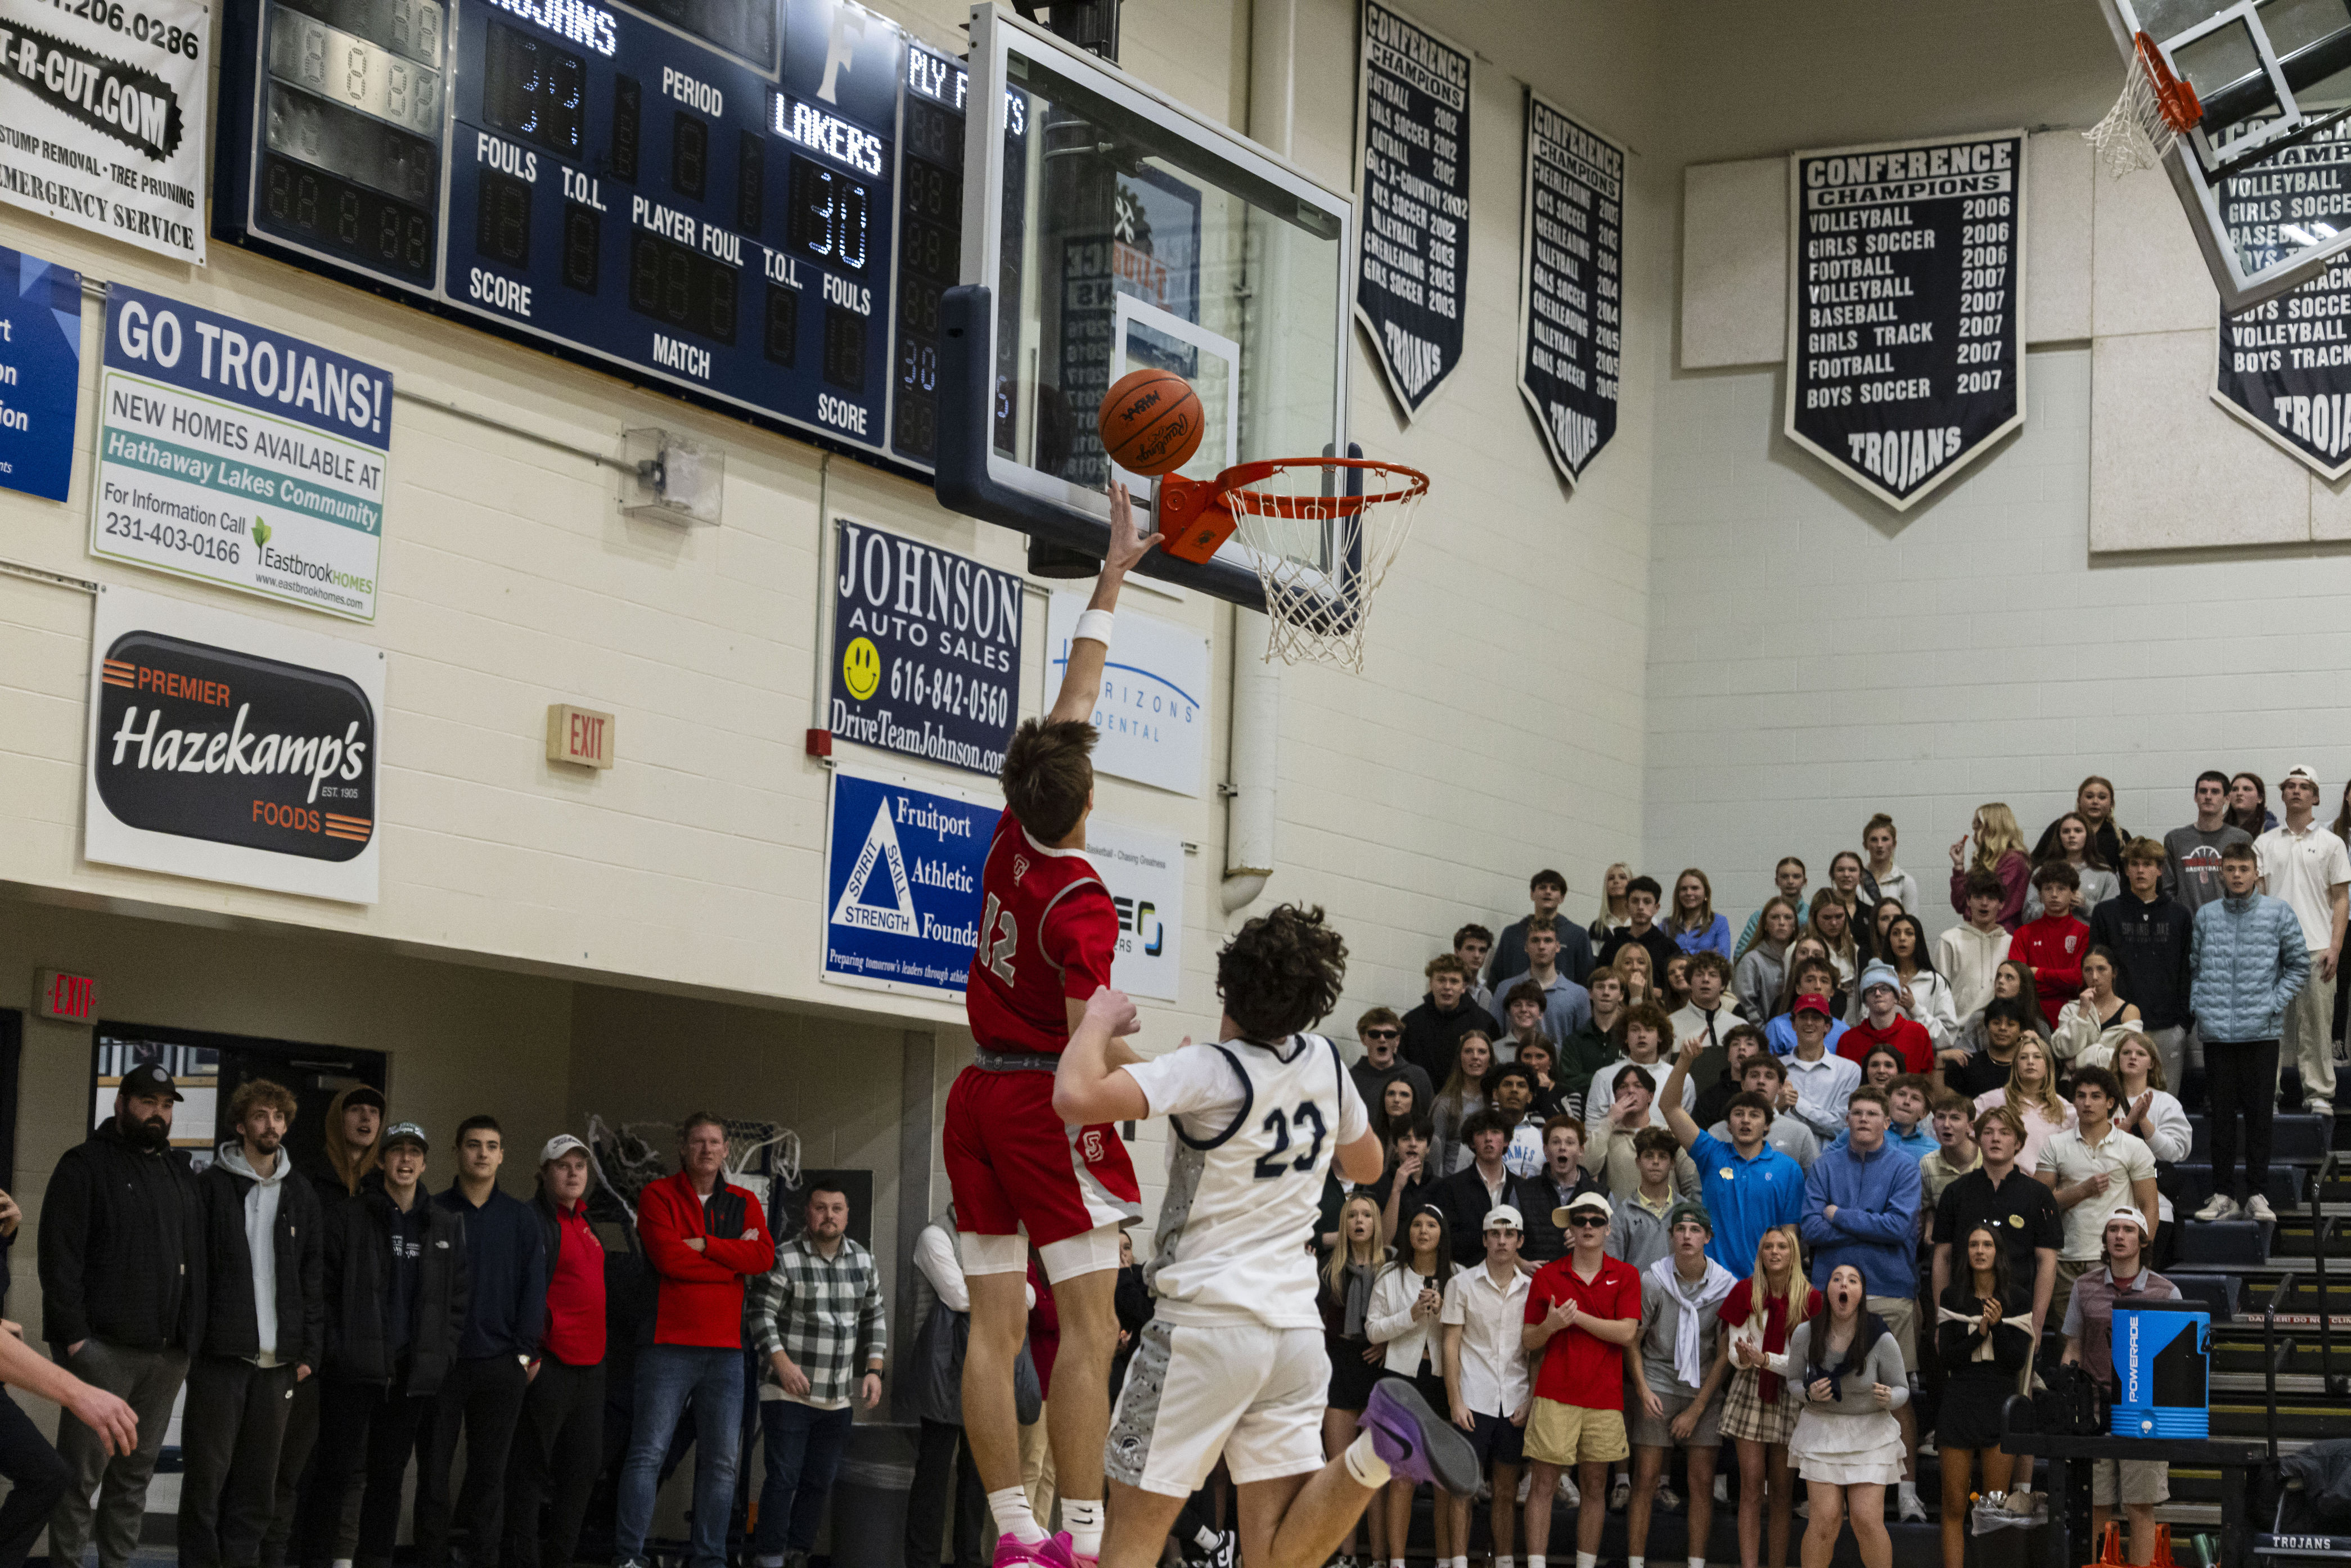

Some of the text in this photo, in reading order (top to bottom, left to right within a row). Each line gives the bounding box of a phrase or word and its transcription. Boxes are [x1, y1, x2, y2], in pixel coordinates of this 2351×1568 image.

[52, 0, 199, 60] .206.0286
[1367, 4, 1467, 89] CONFERENCE
[663, 66, 723, 118] PERIOD
[909, 48, 947, 98] PLY
[1372, 43, 1461, 107] CHAMPIONS
[775, 92, 882, 175] LAKERS
[1393, 112, 1430, 150] SOCCER
[1434, 133, 1457, 163] 2002
[1434, 106, 1457, 136] 2002
[1534, 105, 1622, 182] CONFERENCE
[0, 124, 195, 209] STUMP REMOVAL TREE PRUNING
[476, 132, 537, 183] FOULS
[1433, 157, 1456, 187] 2002
[1539, 140, 1616, 197] CHAMPIONS
[1807, 141, 2012, 189] CONFERENCE
[561, 166, 608, 212] T.O.L.
[1389, 163, 1442, 210] X-COUNTRY
[1817, 174, 2001, 207] CHAMPIONS
[2227, 169, 2341, 197] VOLLEYBALL
[0, 164, 195, 251] MERGENCY SERVICE
[632, 195, 744, 267] PLAYER FOUL
[808, 172, 867, 269] 30
[1372, 178, 1457, 244] OYS SOCCER 2002
[1809, 196, 2011, 233] VOLLEYBALL 2006
[2229, 200, 2282, 224] GIRLS
[1429, 238, 1456, 269] 2003
[1808, 222, 2010, 259] GIRLS SOCCER 2006
[1809, 245, 2008, 282] FOOTBALL 2006
[470, 267, 532, 317] SCORE
[763, 248, 803, 290] T.O.L.
[1429, 264, 1455, 294] 2003
[1809, 267, 2005, 304] VOLLEYBALL 2007
[822, 273, 871, 316] FOULS
[1389, 271, 1424, 307] SOCCER
[1429, 289, 1457, 320] 2003
[1809, 290, 2005, 328] BASEBALL 2007
[653, 333, 711, 380] MATCH
[1808, 314, 2003, 354] GIRLS TRACK 2007
[2232, 319, 2347, 348] VOLLEYBALL
[118, 300, 383, 434] GO TROJANS!
[1384, 319, 1442, 399] TROJANS
[1556, 358, 1587, 391] SOCCER
[1809, 340, 2003, 380] FOOTBALL 2007
[2233, 349, 2282, 373] BOYS
[1807, 370, 2002, 409] BOYS SOCCER 2007
[818, 393, 867, 436] SCORE
[1550, 400, 1598, 472] TROJANS
[2274, 394, 2351, 458] TROJA
[112, 389, 381, 492] NEW HOMES AVAILABLE AT
[1847, 426, 1962, 492] TROJANS
[107, 432, 379, 532] Hathaway Lakes Community
[105, 482, 246, 535] For Information Call
[105, 511, 240, 565] 231-403-0166
[255, 573, 364, 610] www.eastbrookhomes.com
[840, 525, 1021, 648] JOHNSON
[848, 607, 1010, 673] AUTO SALES
[138, 666, 231, 708] PREMIER
[890, 657, 1008, 728] 616-842-0560
[1105, 681, 1192, 724] RIZONS
[570, 713, 605, 761] EXIT
[1095, 711, 1159, 742] DENTAL
[112, 702, 367, 804] Hazekamp's
[252, 799, 321, 833] FOODS
[322, 786, 359, 800] EST. 1905
[895, 796, 971, 842] Fruitport
[849, 837, 877, 898] SPIRIT
[887, 844, 907, 902] SKILL
[910, 855, 974, 894] Athletic
[1086, 843, 1167, 869] Basketball Chasing Greatness
[845, 905, 910, 932] STRENGTH
[921, 912, 979, 949] Founda
[979, 891, 1018, 989] 12
[830, 948, 969, 986] Preparing tomorrow's leaders through athleti
[53, 974, 93, 1019] EXIT
[1254, 1099, 1327, 1180] 23
[2128, 1315, 2140, 1403] POWERADE
[2273, 1536, 2331, 1551] TROJANS
